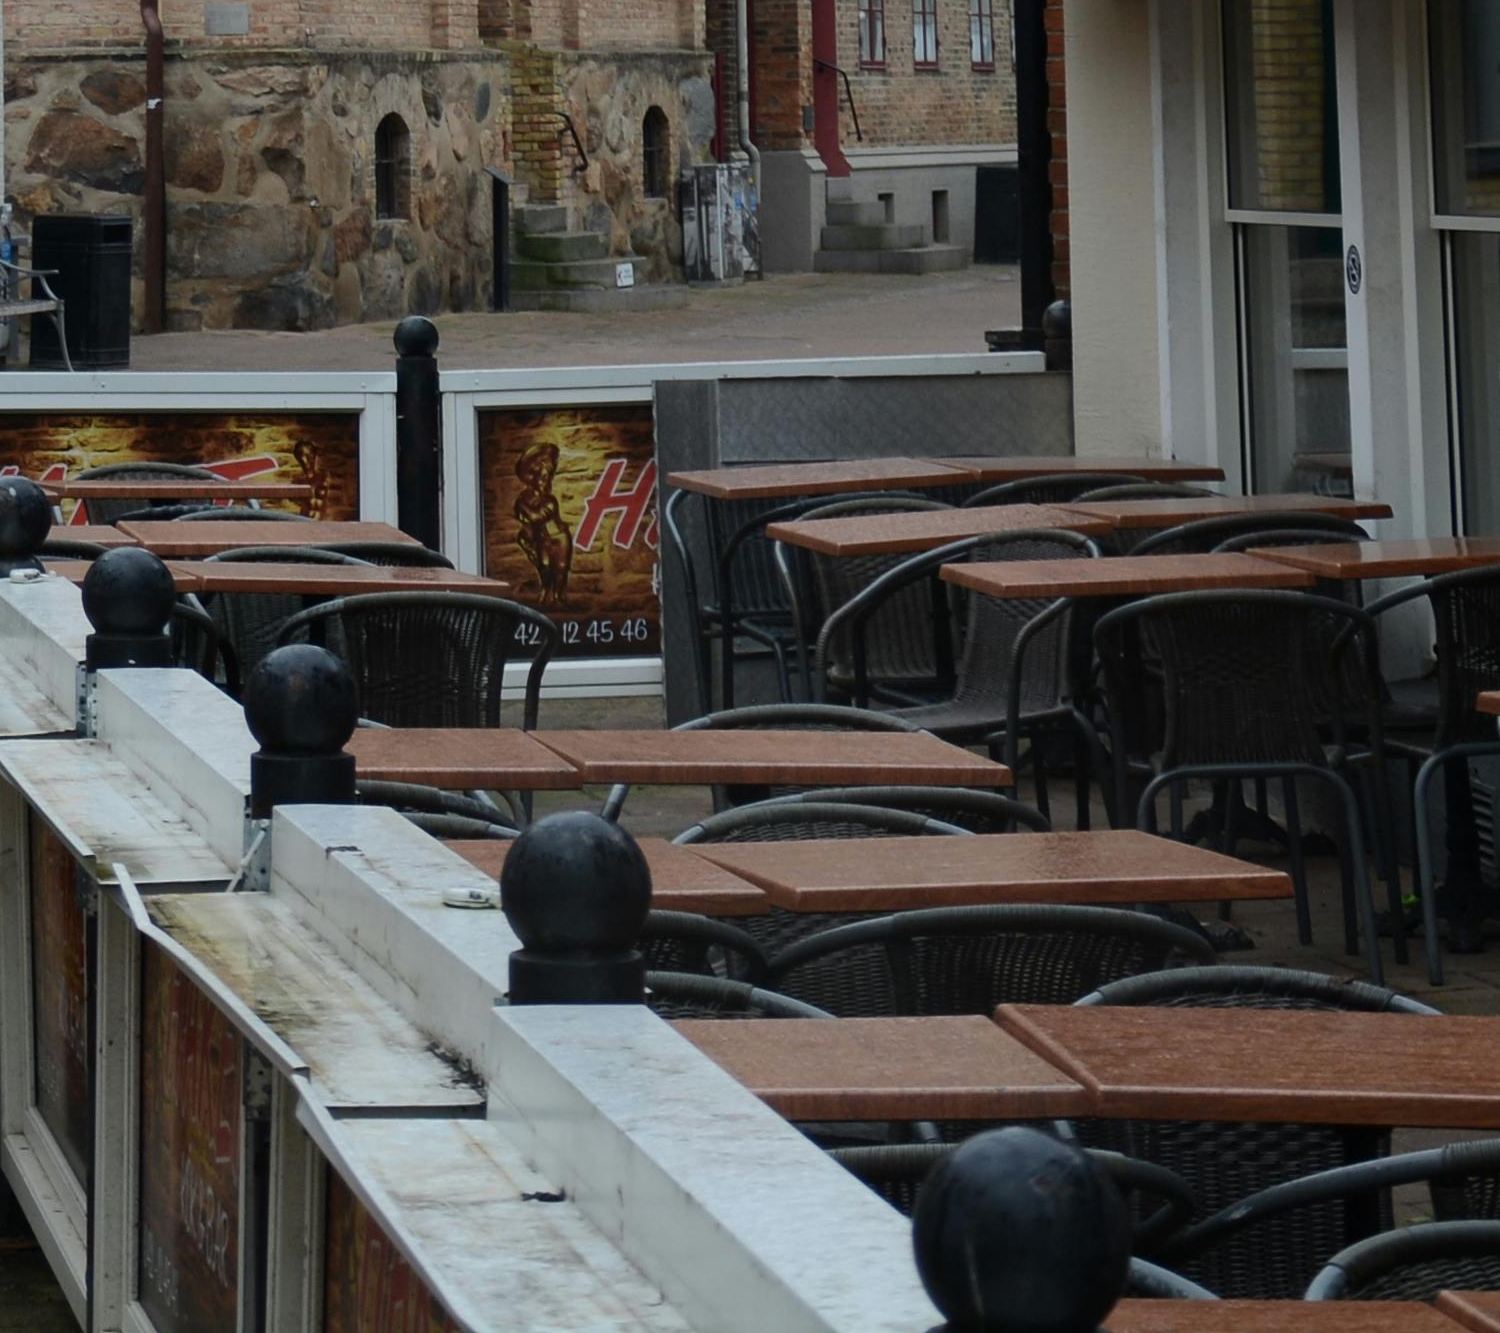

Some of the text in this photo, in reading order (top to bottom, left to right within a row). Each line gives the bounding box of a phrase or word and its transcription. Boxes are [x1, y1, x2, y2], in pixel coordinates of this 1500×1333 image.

[573, 458, 661, 552] H
[563, 621, 581, 644] 12
[586, 619, 614, 644] 45
[620, 618, 648, 642] 46
